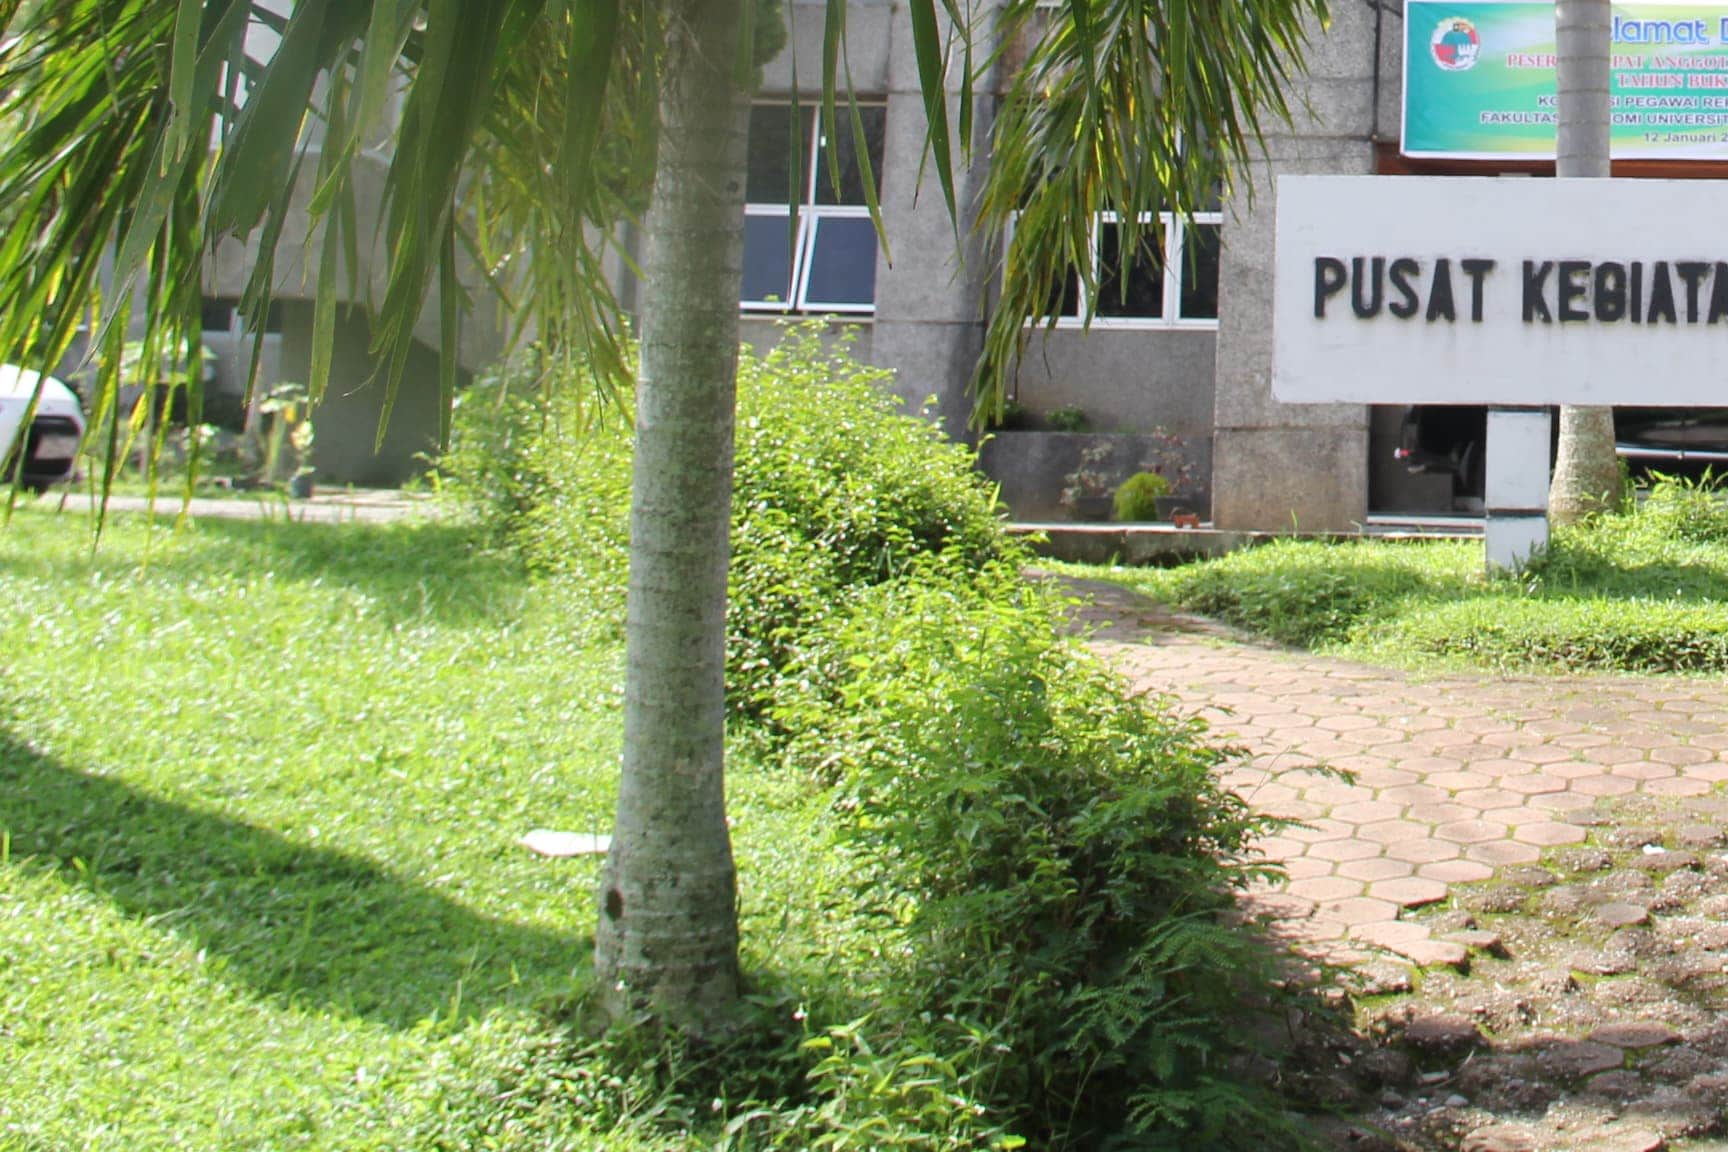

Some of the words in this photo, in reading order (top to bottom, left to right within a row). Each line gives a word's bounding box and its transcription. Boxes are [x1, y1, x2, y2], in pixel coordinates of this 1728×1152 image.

[1610, 17, 1707, 44] lamat
[1507, 54, 1558, 67] PESER
[1613, 56, 1644, 68] PAT
[1618, 75, 1683, 87] TAHUN
[1625, 97, 1697, 108] PEGAWAI
[1481, 112, 1559, 123] FAKULTAS
[1644, 132, 1657, 142] 12
[1664, 132, 1716, 143] Januari
[1314, 256, 1496, 323] PUSAT
